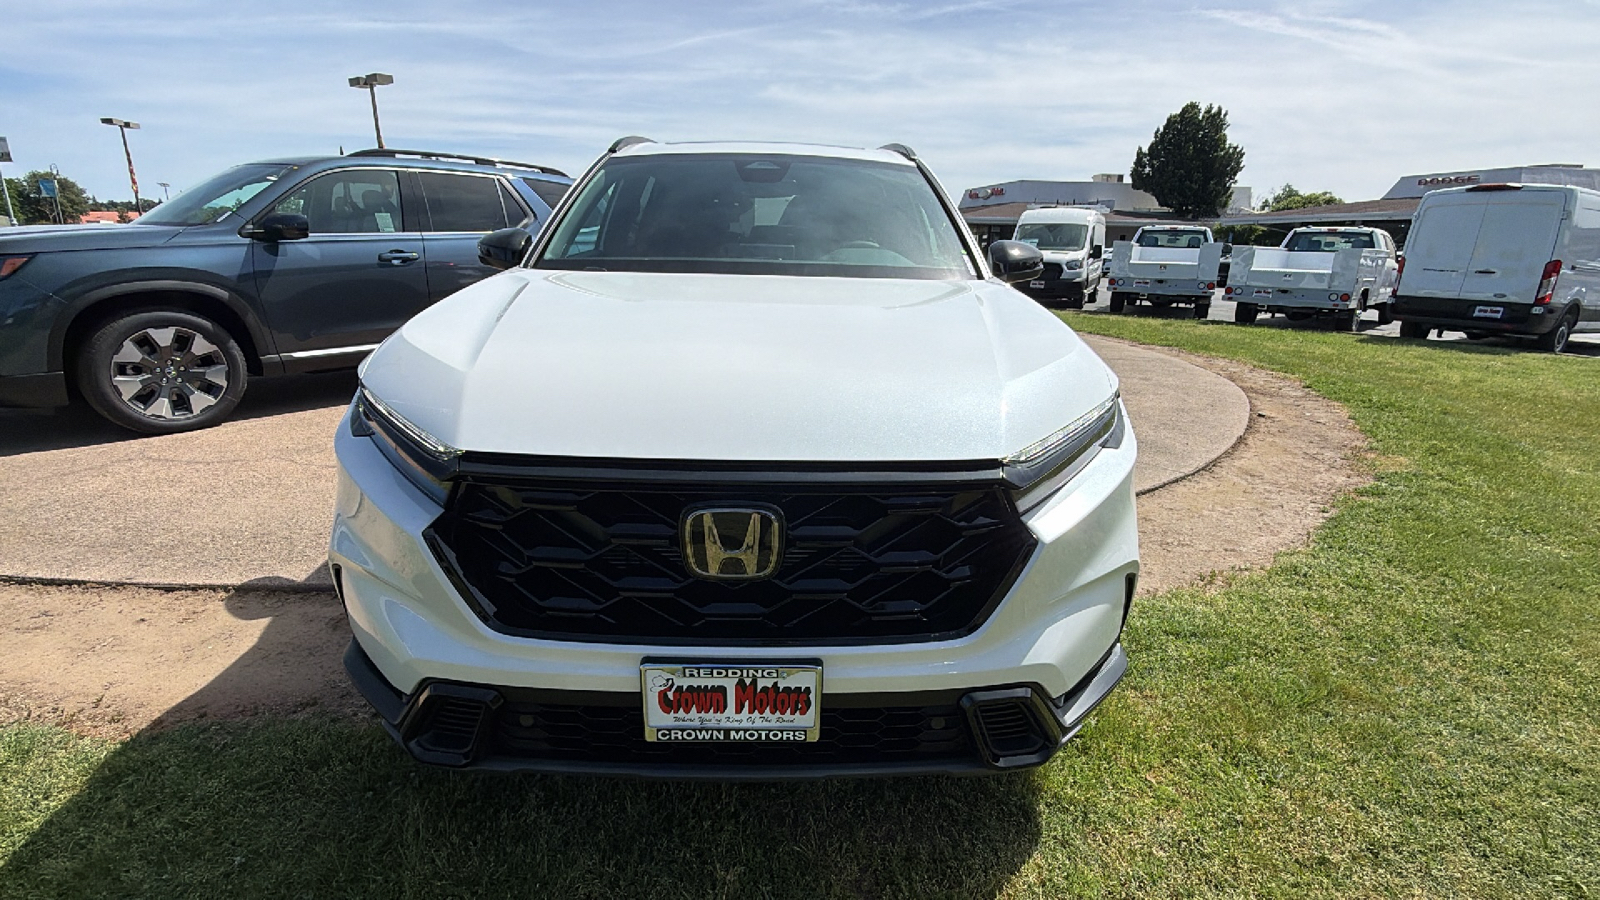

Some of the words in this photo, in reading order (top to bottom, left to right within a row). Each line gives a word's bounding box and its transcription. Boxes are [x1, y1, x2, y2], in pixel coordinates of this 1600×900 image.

[1417, 174, 1481, 186] DODGE
[684, 668, 778, 678] REDDING
[657, 677, 728, 715] Crown
[734, 678, 812, 716] Motors
[725, 716, 743, 725] King
[746, 716, 756, 725] Of
[775, 716, 796, 724] Road
[657, 729, 725, 740] CROWN
[729, 730, 806, 741] MOTORS
